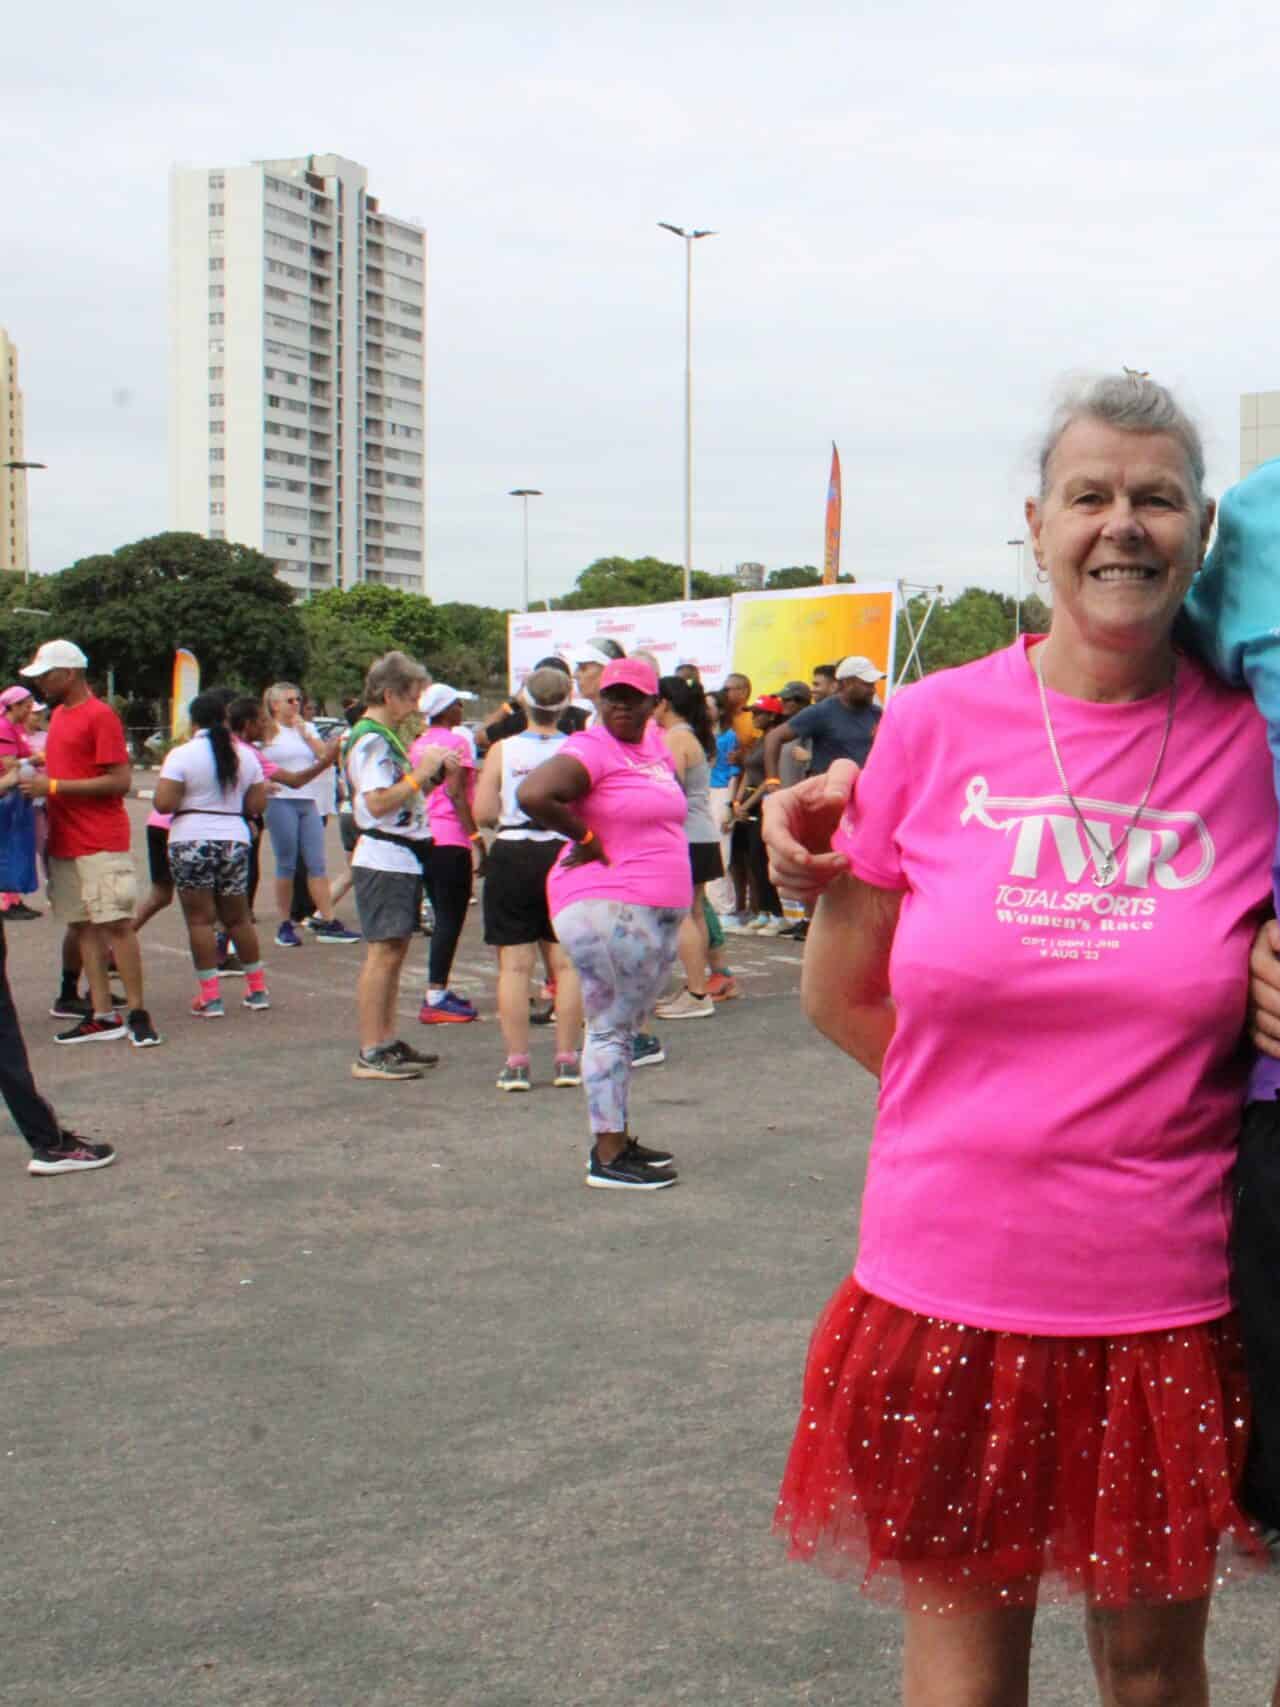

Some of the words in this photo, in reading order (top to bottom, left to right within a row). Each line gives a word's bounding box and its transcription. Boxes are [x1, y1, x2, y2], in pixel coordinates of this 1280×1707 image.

[994, 884, 1157, 916] TOTALSPORTS
[996, 908, 1091, 931] Women's
[1100, 919, 1153, 932] Race
[1051, 949, 1079, 959] AUG
